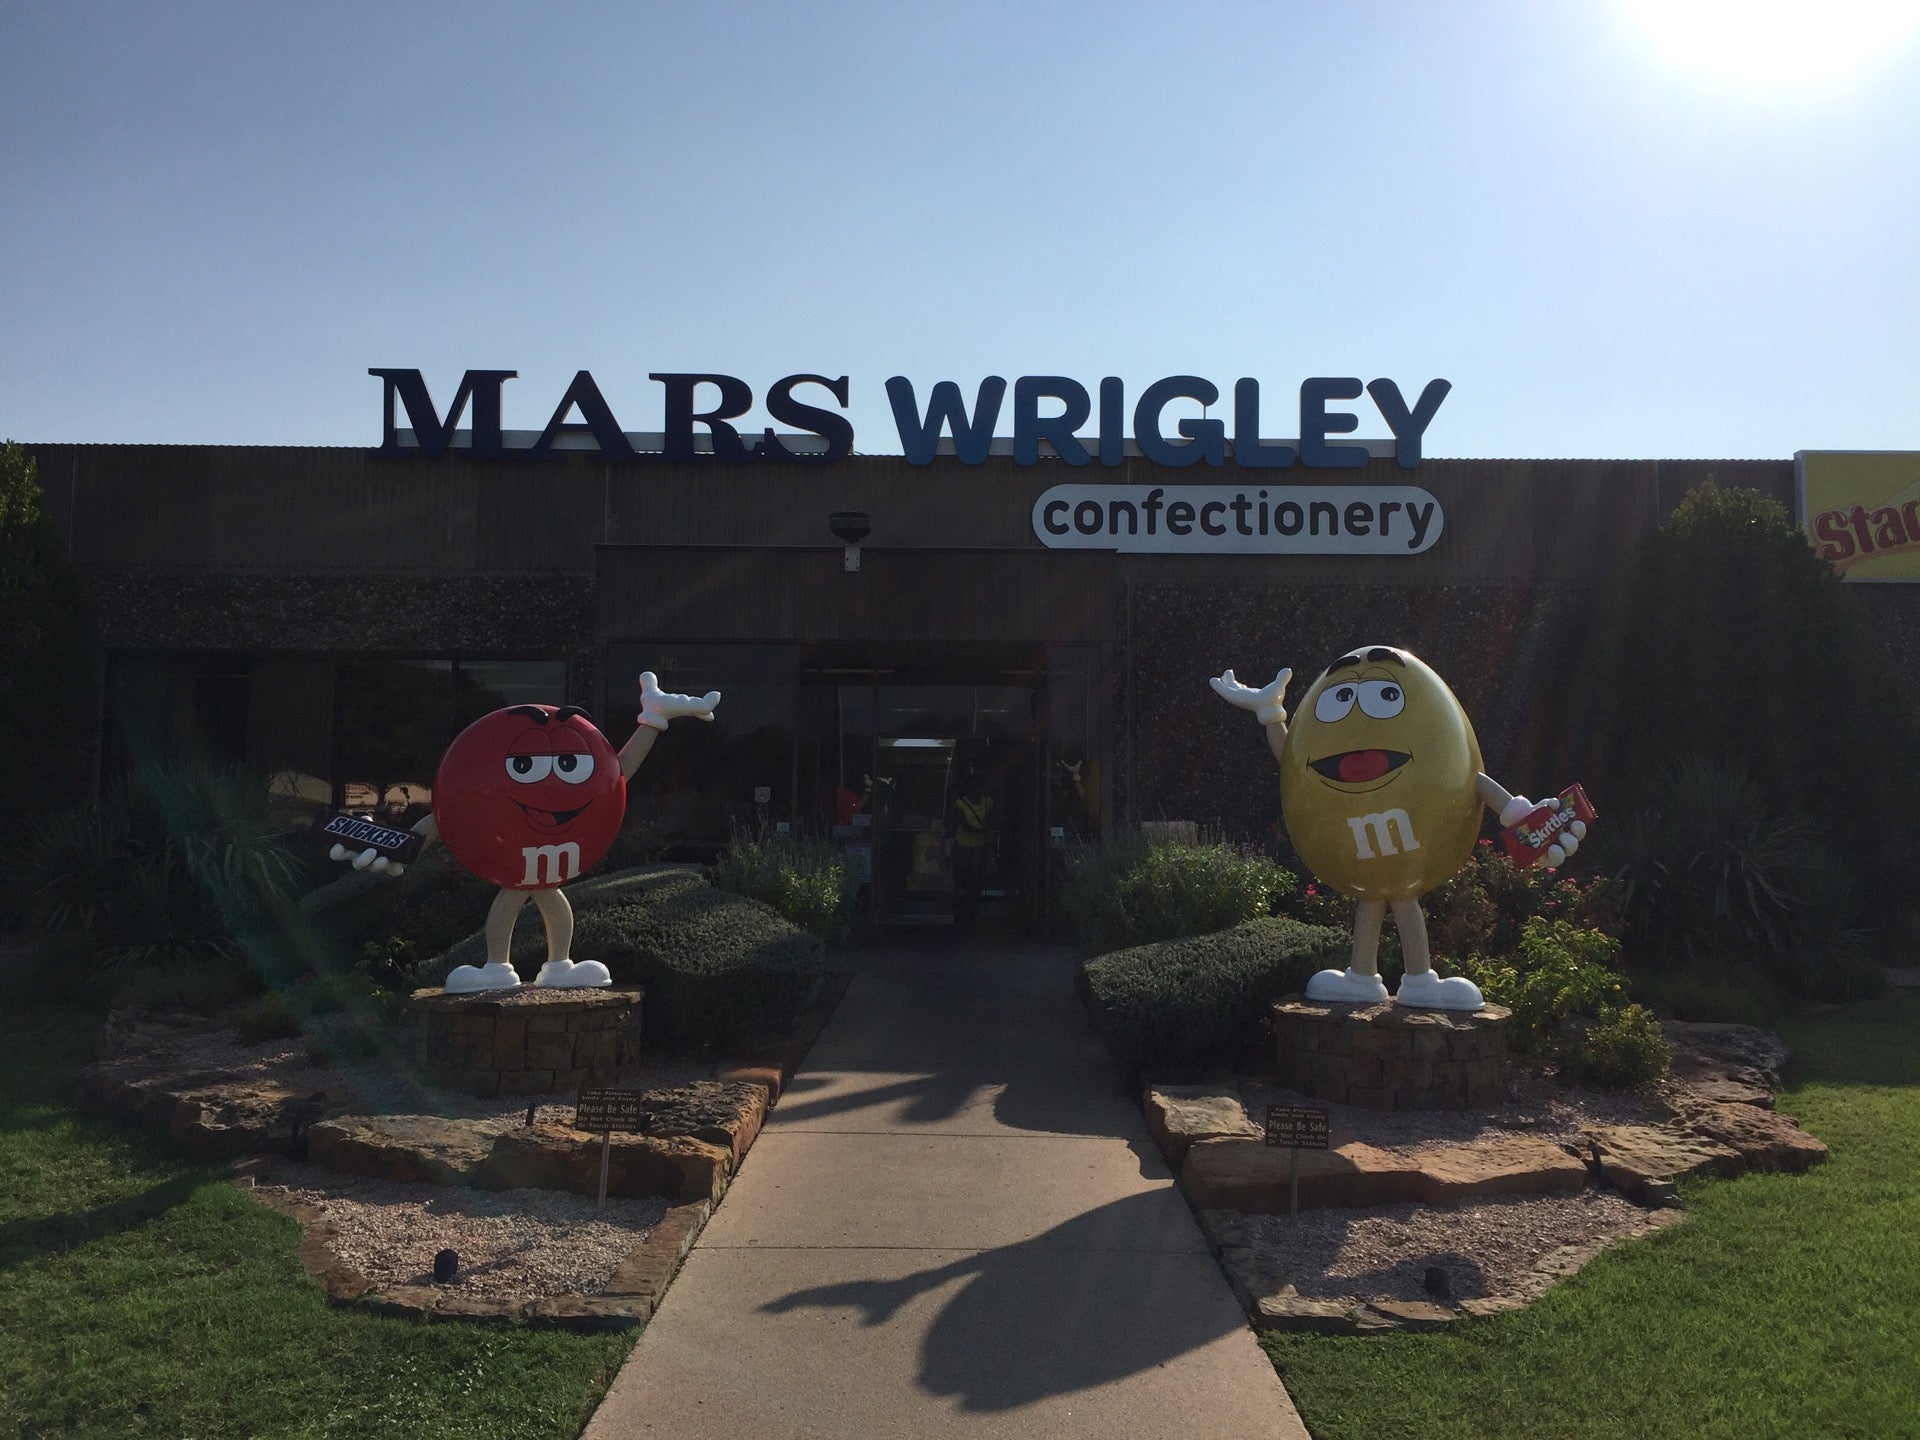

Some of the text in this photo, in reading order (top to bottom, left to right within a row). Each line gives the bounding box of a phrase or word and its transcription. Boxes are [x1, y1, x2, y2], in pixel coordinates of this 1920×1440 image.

[368, 368, 1452, 469] MARS WRIGLEY
[1043, 489, 1434, 548] confectionery
[327, 817, 406, 847] SNICKERS
[1347, 808, 1421, 859] m
[1528, 807, 1576, 848] Skittles
[516, 841, 580, 886] m
[579, 1104, 638, 1114] Please Be Safe
[1269, 1120, 1327, 1133] Please Be Safe
